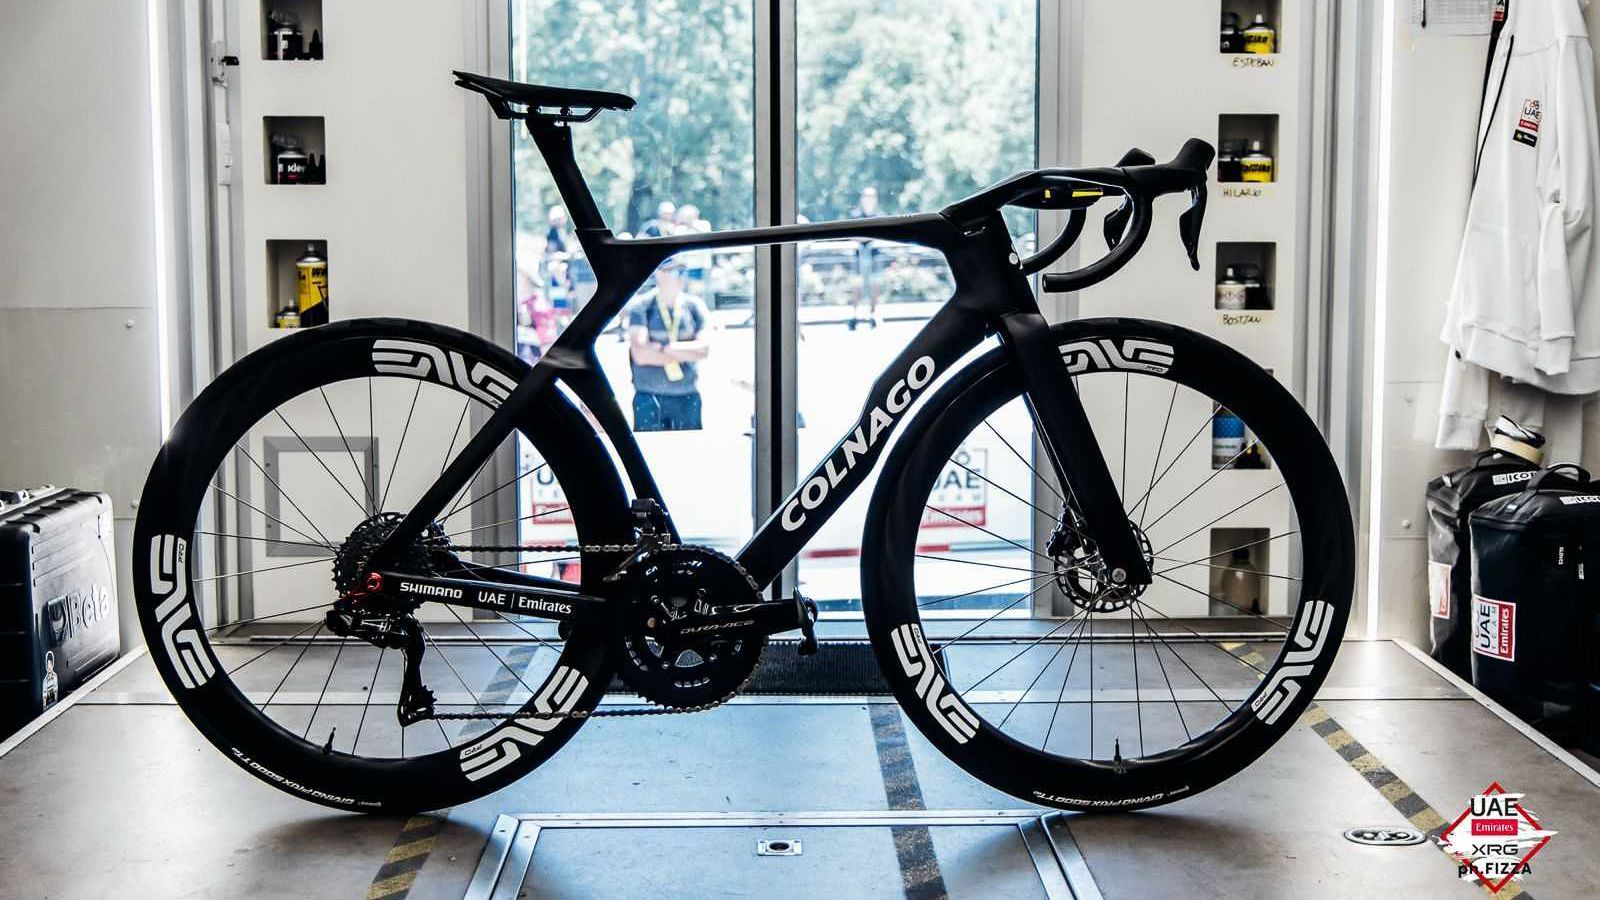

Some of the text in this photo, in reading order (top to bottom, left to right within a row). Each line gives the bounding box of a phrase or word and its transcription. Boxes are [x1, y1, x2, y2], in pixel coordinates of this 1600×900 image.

[1232, 57, 1274, 67] ESTEBAN
[781, 355, 935, 531] COLNAGO
[70, 584, 110, 629] Beta
[150, 534, 216, 689] ENVE
[400, 581, 572, 614] SHIMANO UAE Emirates
[1480, 604, 1491, 649] UAE
[1500, 608, 1510, 654] Emirates
[890, 623, 980, 744] ENVE
[1250, 600, 1335, 725] ENVE
[459, 665, 589, 782] ENVE
